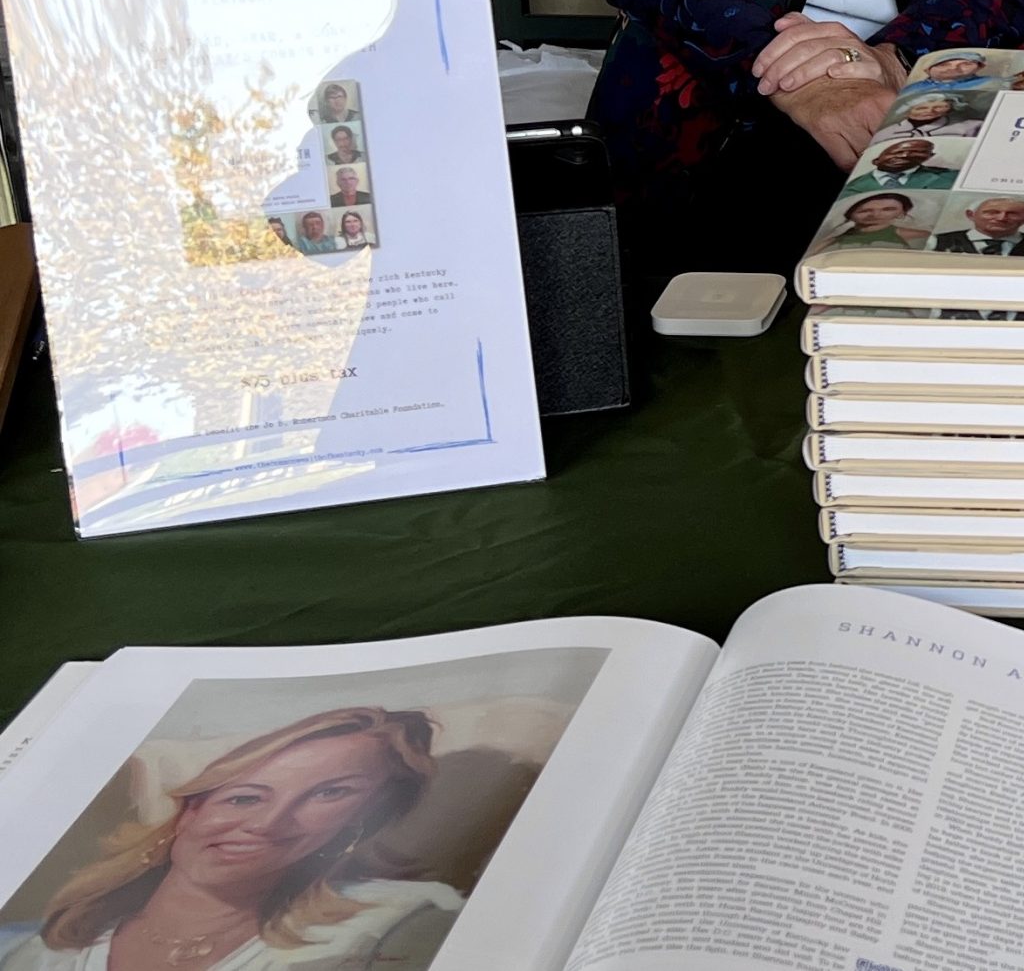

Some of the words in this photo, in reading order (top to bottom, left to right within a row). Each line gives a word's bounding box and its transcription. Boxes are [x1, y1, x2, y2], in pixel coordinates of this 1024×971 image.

[404, 268, 447, 281] Kentucky
[406, 283, 428, 292] live
[330, 366, 358, 379] tax
[341, 407, 389, 420] Charitable
[838, 621, 988, 669] SHANNON
